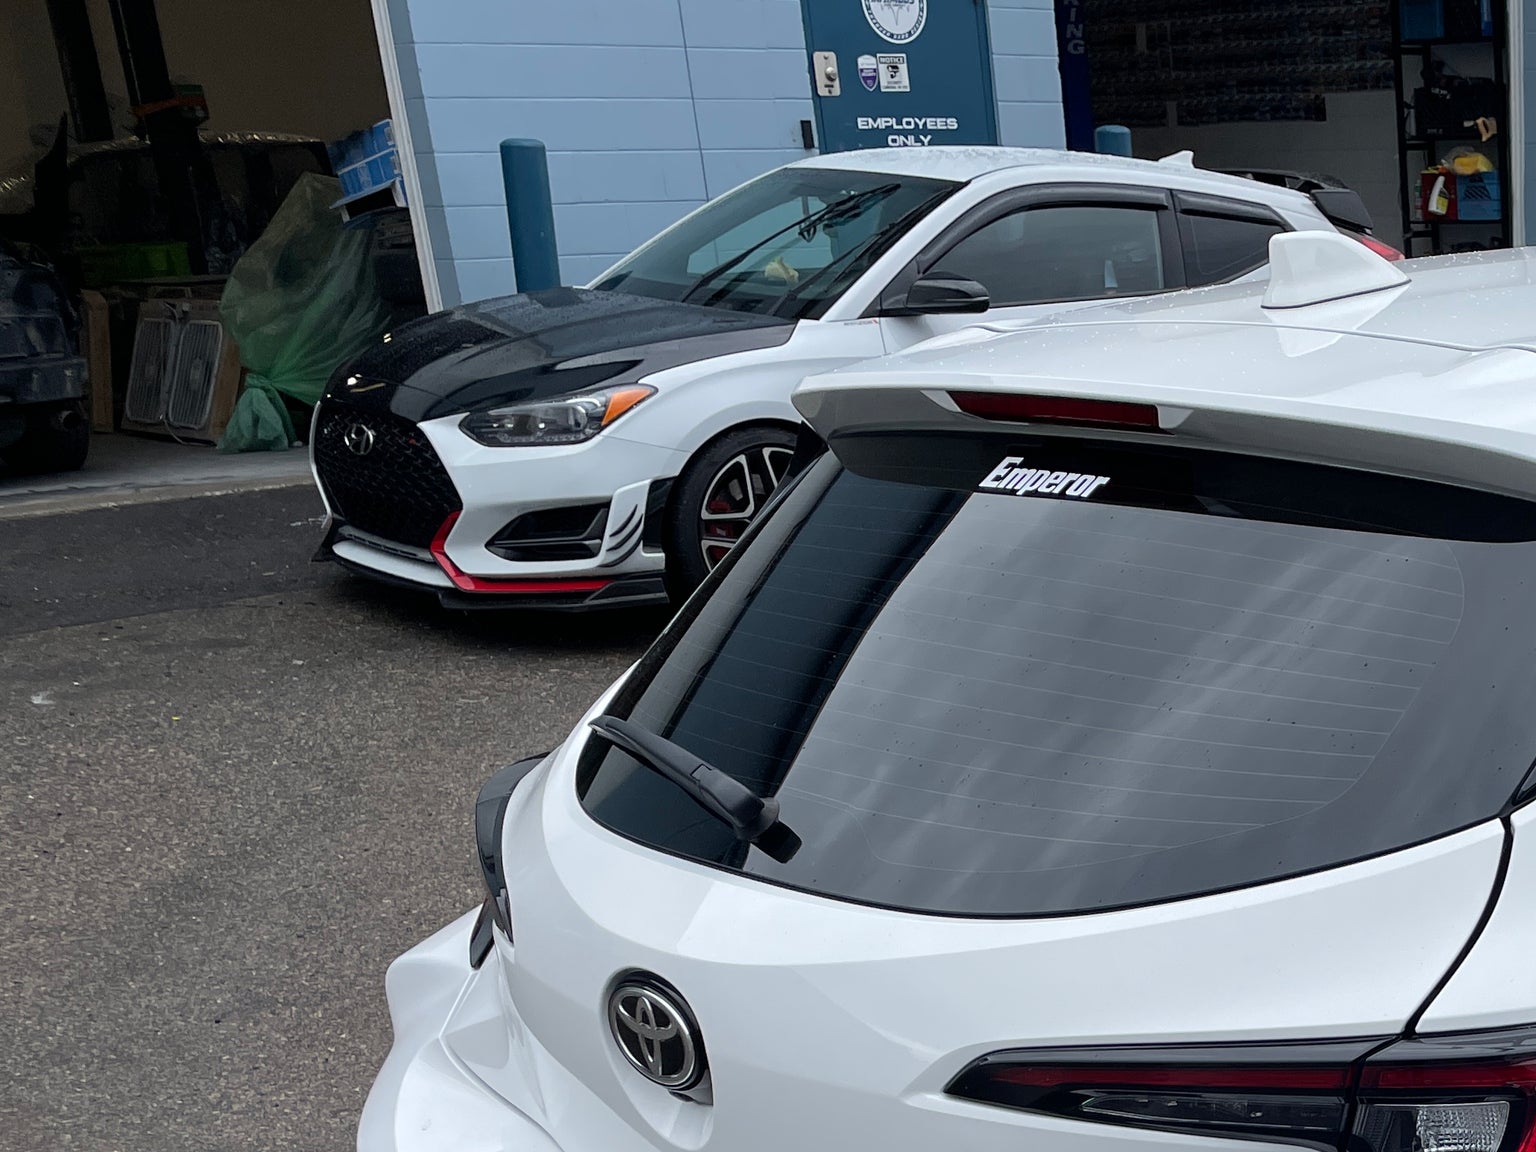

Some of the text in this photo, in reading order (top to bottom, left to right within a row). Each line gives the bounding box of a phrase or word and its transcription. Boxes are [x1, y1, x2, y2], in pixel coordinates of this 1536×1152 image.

[857, 117, 958, 130] EMPLOYEES
[887, 134, 932, 147] ONLY
[978, 456, 1111, 498] Emperor
